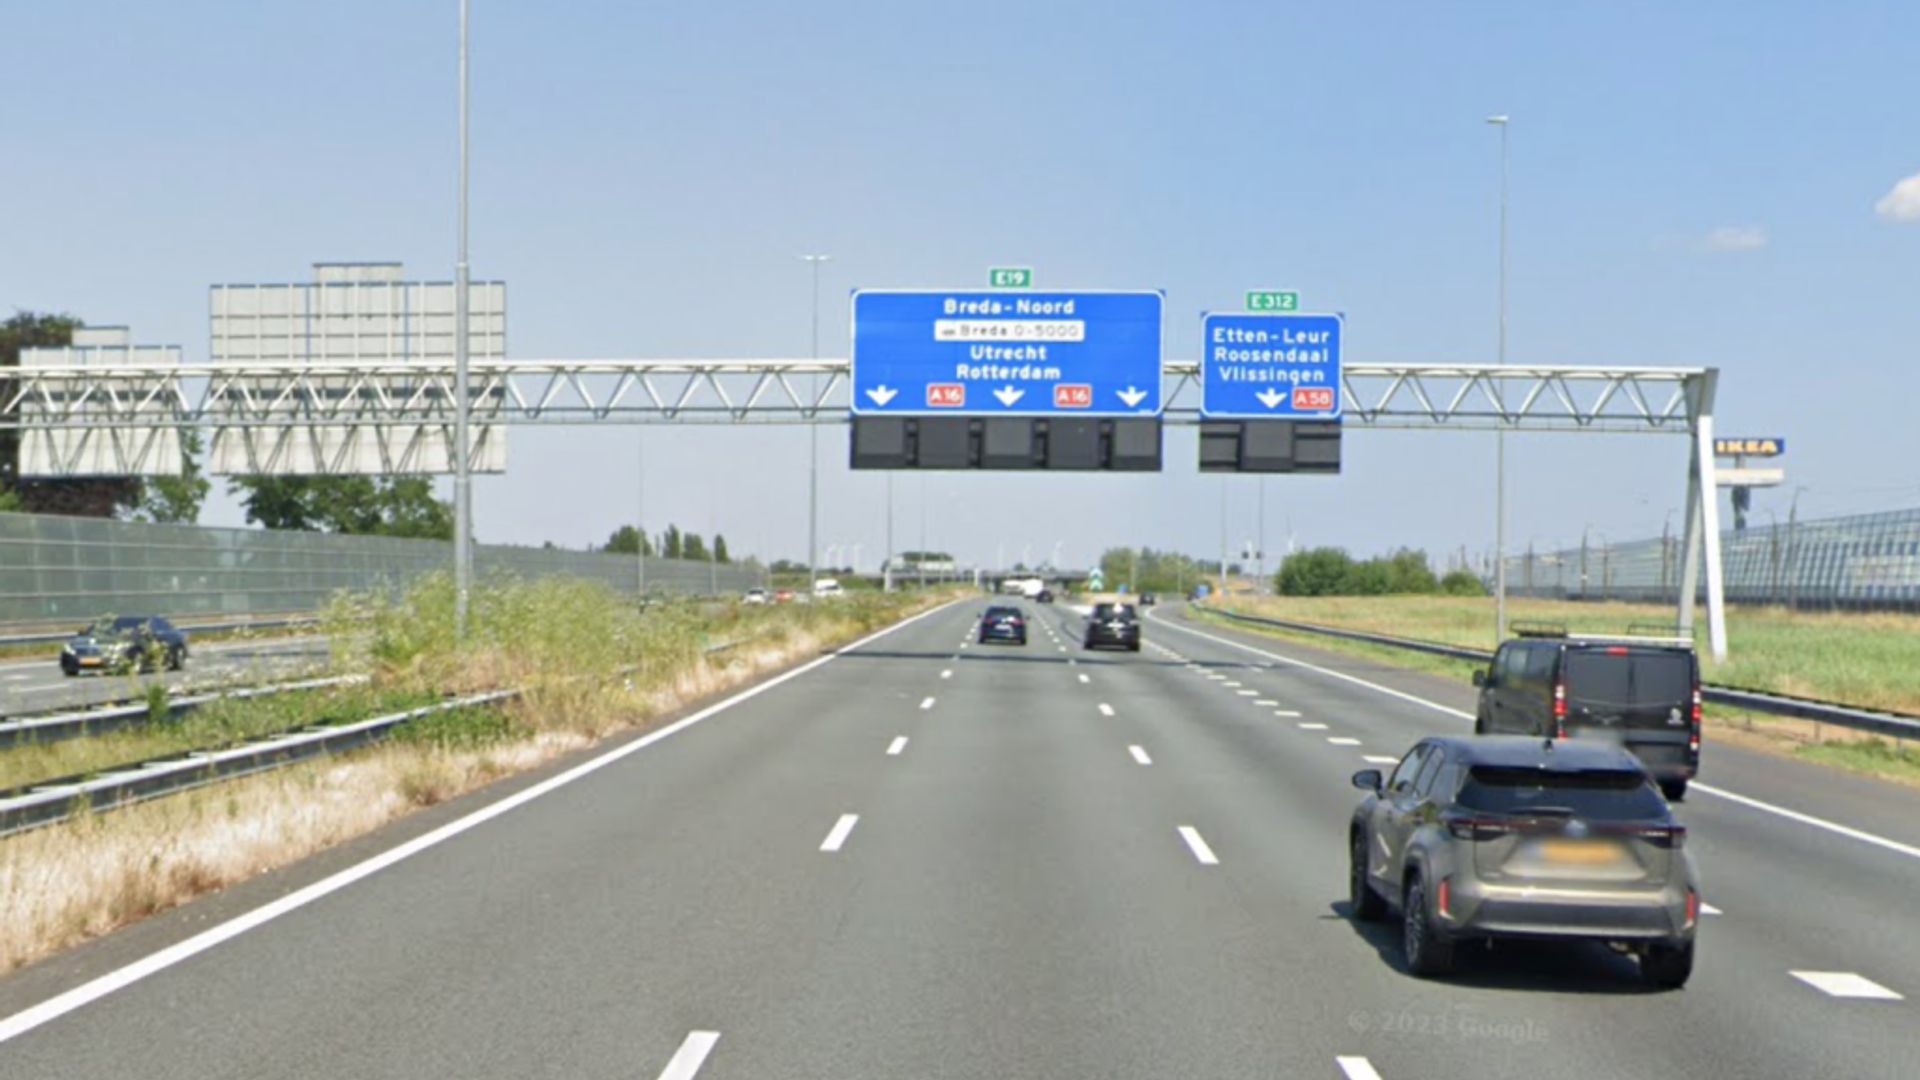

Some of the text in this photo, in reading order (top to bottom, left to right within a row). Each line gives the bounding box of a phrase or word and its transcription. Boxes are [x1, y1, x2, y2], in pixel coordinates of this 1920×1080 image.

[960, 324, 1078, 337] Breda 0-5000
[970, 345, 1048, 360] Utrecht
[1214, 347, 1329, 363] Roosendaal
[956, 364, 1061, 379] Rotterdam
[1219, 366, 1325, 385] Vlissingen
[1716, 440, 1777, 454] IKEA
